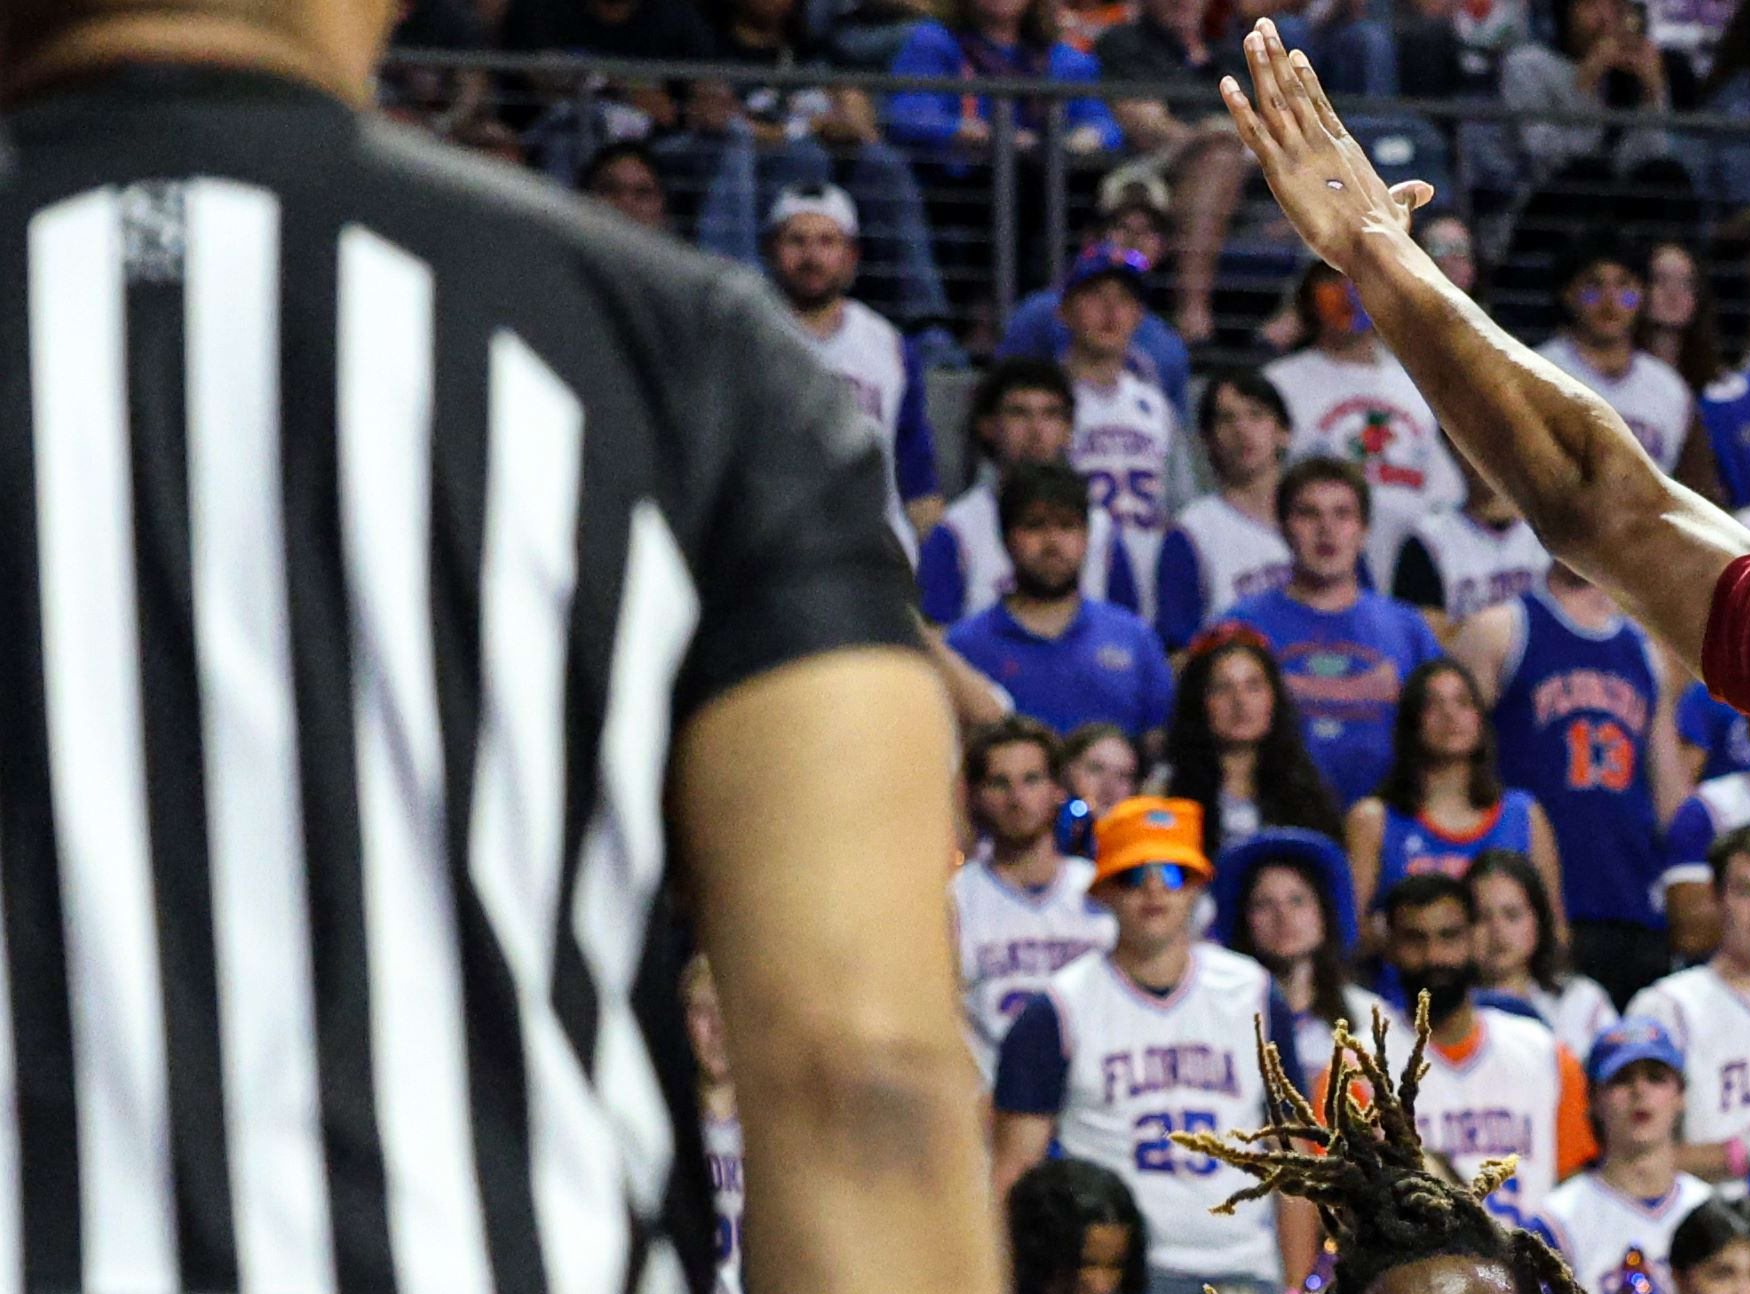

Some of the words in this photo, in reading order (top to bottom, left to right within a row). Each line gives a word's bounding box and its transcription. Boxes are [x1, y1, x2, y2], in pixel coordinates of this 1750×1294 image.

[1568, 719, 1634, 791] 13
[1103, 1044, 1241, 1104] FLORIDA
[1135, 1111, 1217, 1175] 25
